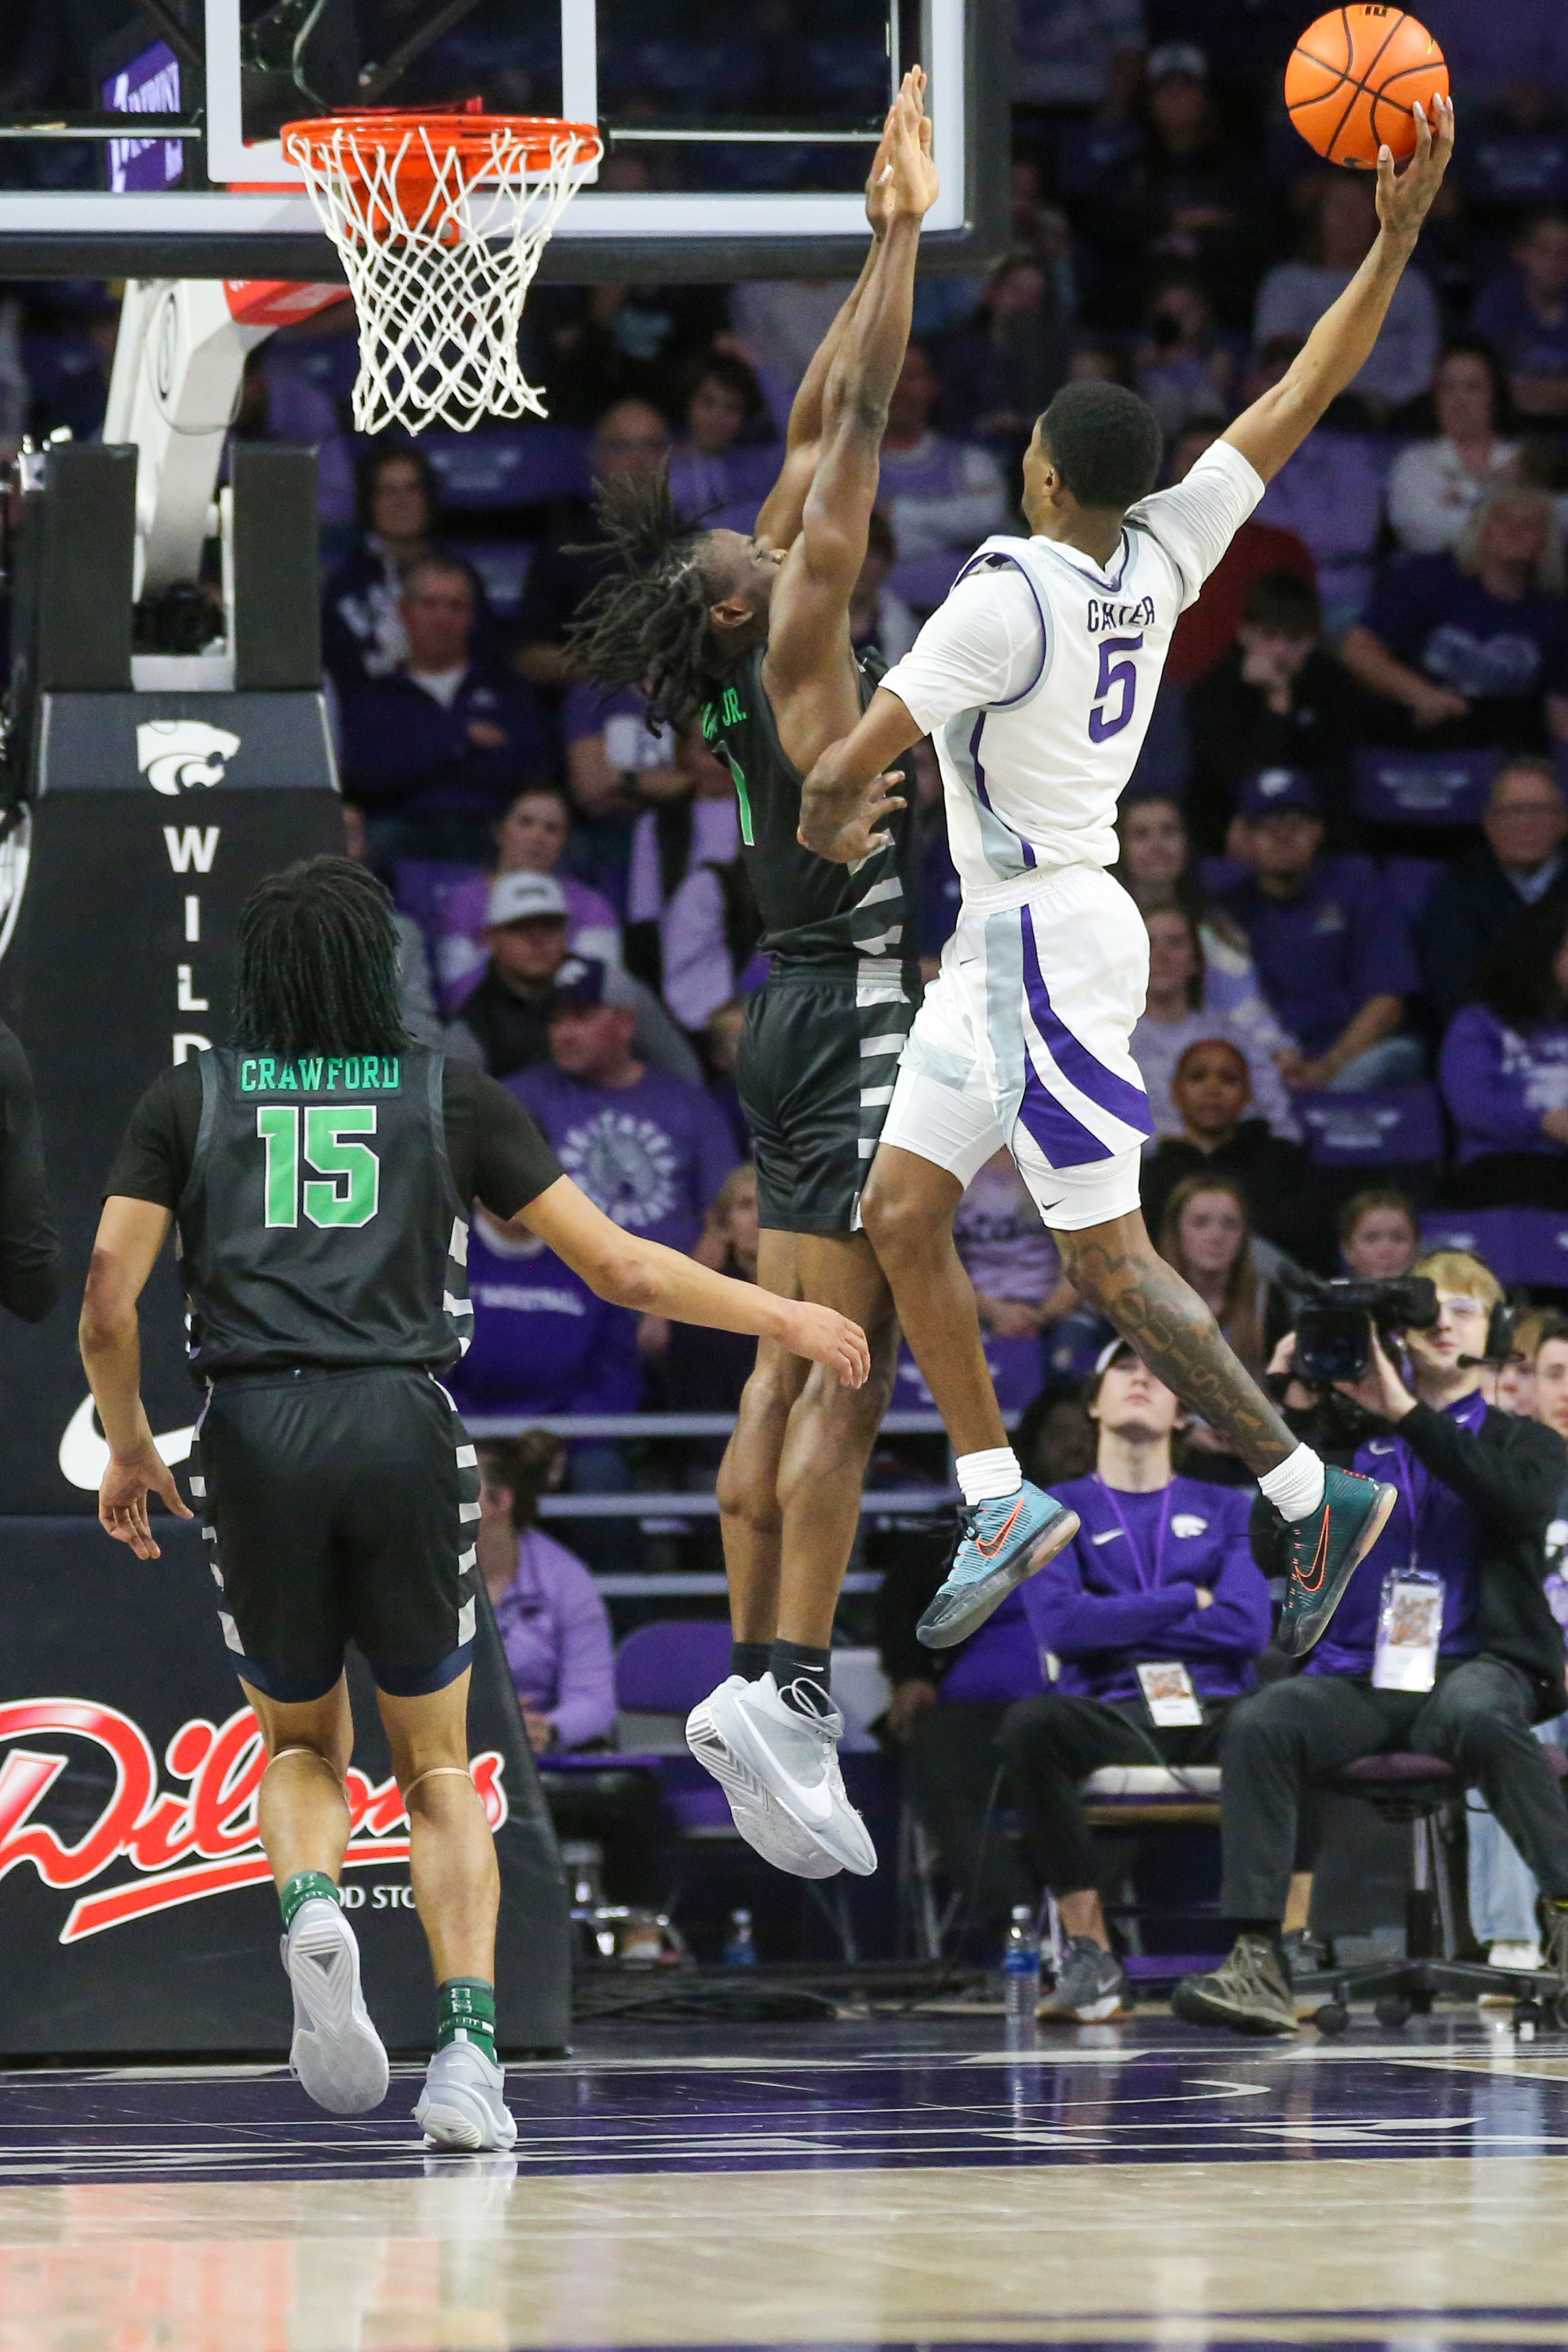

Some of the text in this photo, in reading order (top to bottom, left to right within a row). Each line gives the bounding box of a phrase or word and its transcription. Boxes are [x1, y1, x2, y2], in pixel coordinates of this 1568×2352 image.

[721, 687, 747, 727] JR.
[1089, 632, 1143, 743] 5
[240, 1055, 400, 1092] CRAWFORD
[257, 1105, 380, 1228] 15
